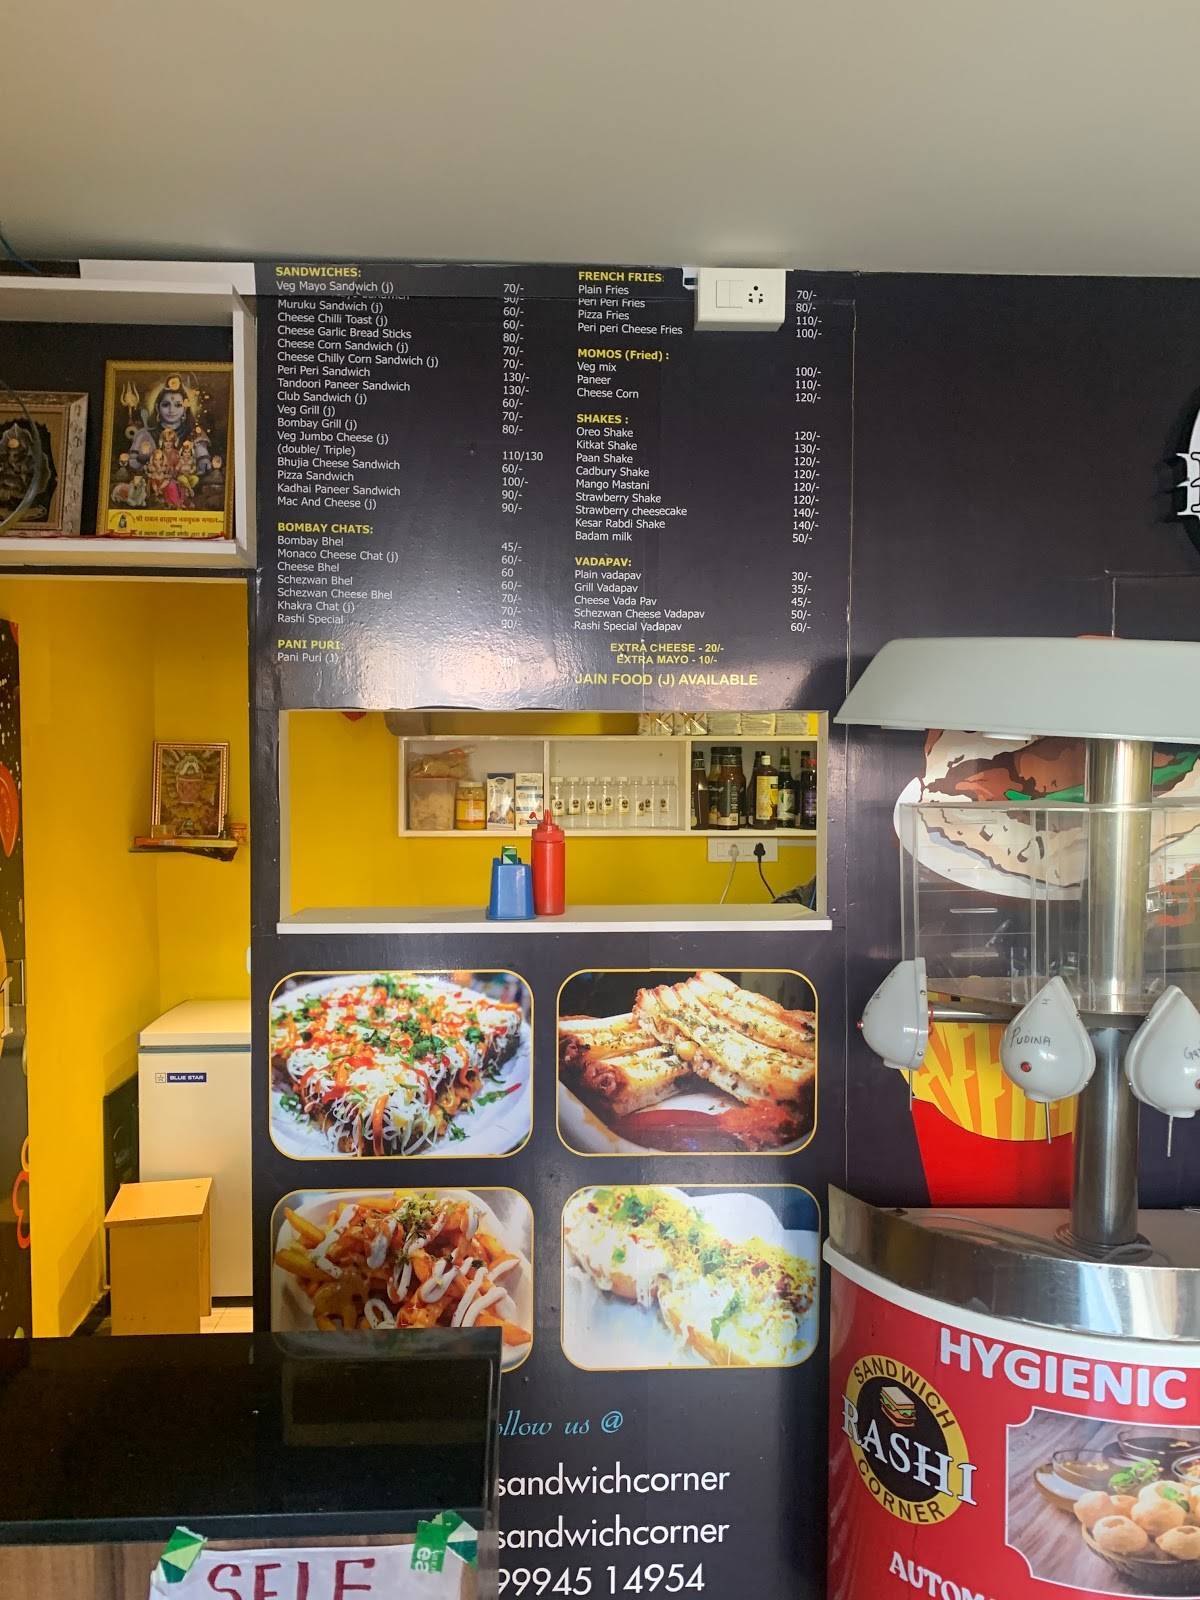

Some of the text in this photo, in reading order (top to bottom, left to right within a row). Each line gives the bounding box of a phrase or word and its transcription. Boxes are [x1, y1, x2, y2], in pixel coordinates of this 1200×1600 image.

[275, 267, 361, 276] SANDWICHES:
[578, 271, 624, 281] FRENCH
[276, 280, 377, 292] Veg Mayo Sandwich
[503, 283, 524, 294] 70/-
[578, 284, 629, 294] Plain Fries
[278, 299, 367, 311] Muruku Sandwich
[277, 312, 372, 324] Cheese Chilli Toast
[578, 309, 629, 320] Pizza Fries
[796, 315, 822, 327] 110/-
[277, 325, 411, 339] Cheese Garlic Bread Sticks
[578, 322, 682, 334] Peri peri Cheese Fries
[503, 332, 523, 344] 80/-
[277, 338, 392, 351] Cheese Corn Sandwich
[277, 351, 422, 365] Cheese Chilly Corn Sandwich
[578, 348, 662, 361] MOMOS (Fried)
[277, 364, 370, 376] Peri Peri Sandwich
[577, 361, 616, 373] Veg mix
[503, 372, 529, 383] 130/-
[577, 374, 611, 384] Paneer
[278, 378, 410, 391] Tandoori Paneer Sandwich
[796, 379, 820, 390] 110/-
[277, 391, 351, 402] Club Sandwich
[502, 411, 522, 422] 70/-
[576, 413, 621, 423] SHAKES
[277, 417, 341, 429] Bombay Grill
[277, 431, 373, 442] Veg Jumbo Cheese
[576, 426, 633, 437] Oreo Shake
[323, 445, 355, 457] Triple)
[795, 443, 820, 454] 130/-
[503, 450, 543, 461] 110/130
[576, 453, 633, 463] Paan Shake
[277, 457, 399, 469] Bhujia Cheese Sandwich
[277, 469, 353, 481] Pizza Sandwich
[575, 465, 649, 478] Cadbury Shake
[503, 476, 528, 488] 100/-
[576, 479, 649, 490] Mango Mastani
[794, 482, 819, 493] 120/-
[277, 483, 400, 495] Kadhai Paneer Sandwich
[277, 496, 360, 507] Mac And Cheese
[575, 492, 661, 503] Strawberry Shake
[575, 504, 687, 517] Strawberry cheesecake
[278, 522, 373, 534] BOMBAY CHATS:
[575, 518, 665, 528] Kesar Rabdi Shake
[793, 520, 818, 531] 140/-
[277, 535, 343, 547] Bombay Bhel
[575, 530, 632, 541] Badam milk
[501, 542, 521, 552] 45/-
[277, 548, 383, 560] Monaco Cheese Chat
[277, 561, 339, 572] Cheese Bhel
[574, 557, 631, 566] VADAPAV:
[575, 569, 641, 581] Plain vadapav
[501, 580, 521, 591] 60/-
[791, 584, 811, 595] 35/-
[277, 587, 392, 599] Schezwan Cheese Bhel
[574, 595, 656, 605] Cheese Vada Pav
[278, 613, 343, 625] Rashi Special
[574, 607, 704, 619] Schezwan Cheese Vadapav
[574, 620, 682, 632] Rashi Special Vadapav
[790, 622, 810, 632] 60/-
[610, 643, 724, 652] EXTRA CHEESE 20/-
[617, 654, 717, 664] EXTRA MAYO 10/-
[574, 674, 757, 688] JAIN FOOD (J) AVAILABLE
[1010, 1027, 1051, 1046] PUDINA
[940, 1328, 1187, 1409] HYGIENIC
[853, 1357, 956, 1429] SANDWICH
[564, 1418, 591, 1435] us
[841, 1394, 978, 1506] RASHI
[858, 1459, 945, 1523] CORNER
[606, 1562, 706, 1595] 14954
